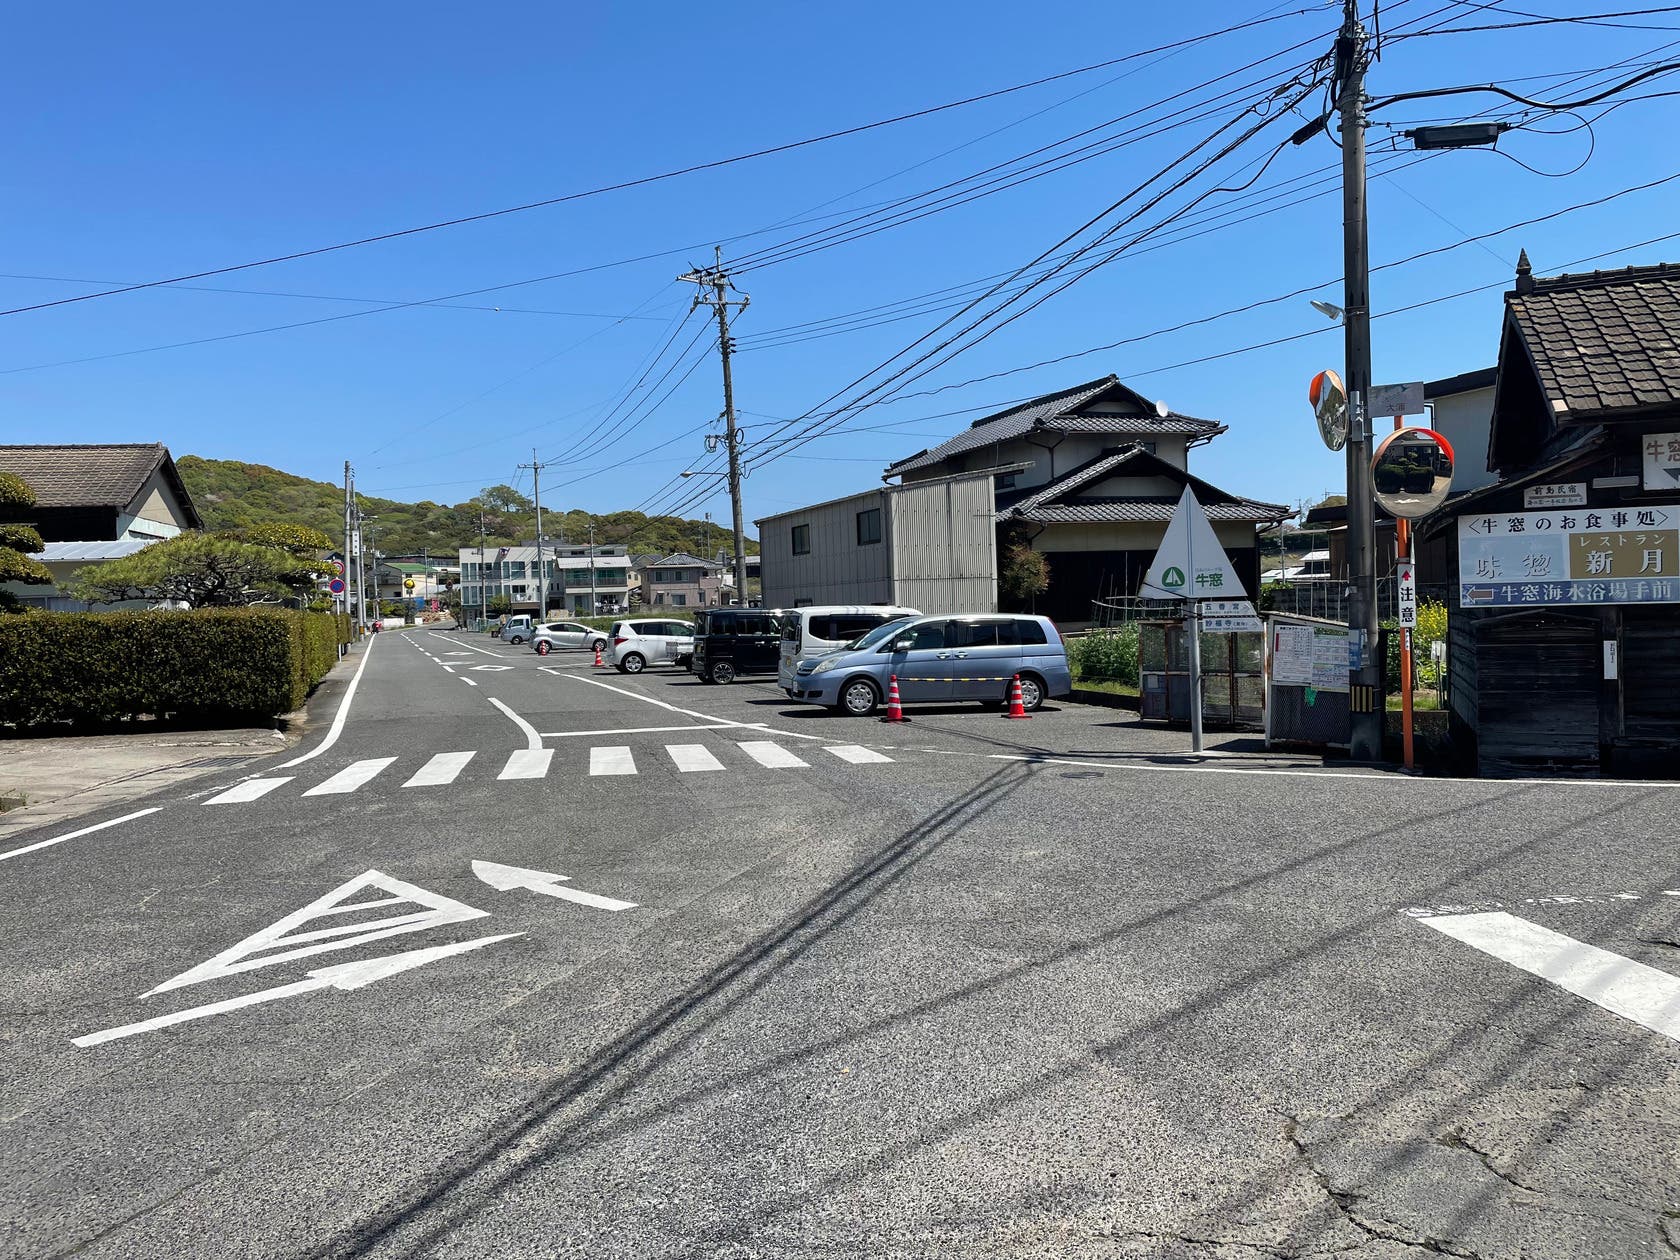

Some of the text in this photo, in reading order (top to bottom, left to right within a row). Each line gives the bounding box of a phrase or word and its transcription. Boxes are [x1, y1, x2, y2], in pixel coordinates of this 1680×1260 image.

[1580, 534, 1665, 548] レストラン
[1585, 549, 1664, 575] 新月
[1195, 572, 1223, 588] 牛窓
[1500, 581, 1672, 602] 牛窓海水浴場手前
[1400, 586, 1415, 623] 注意
